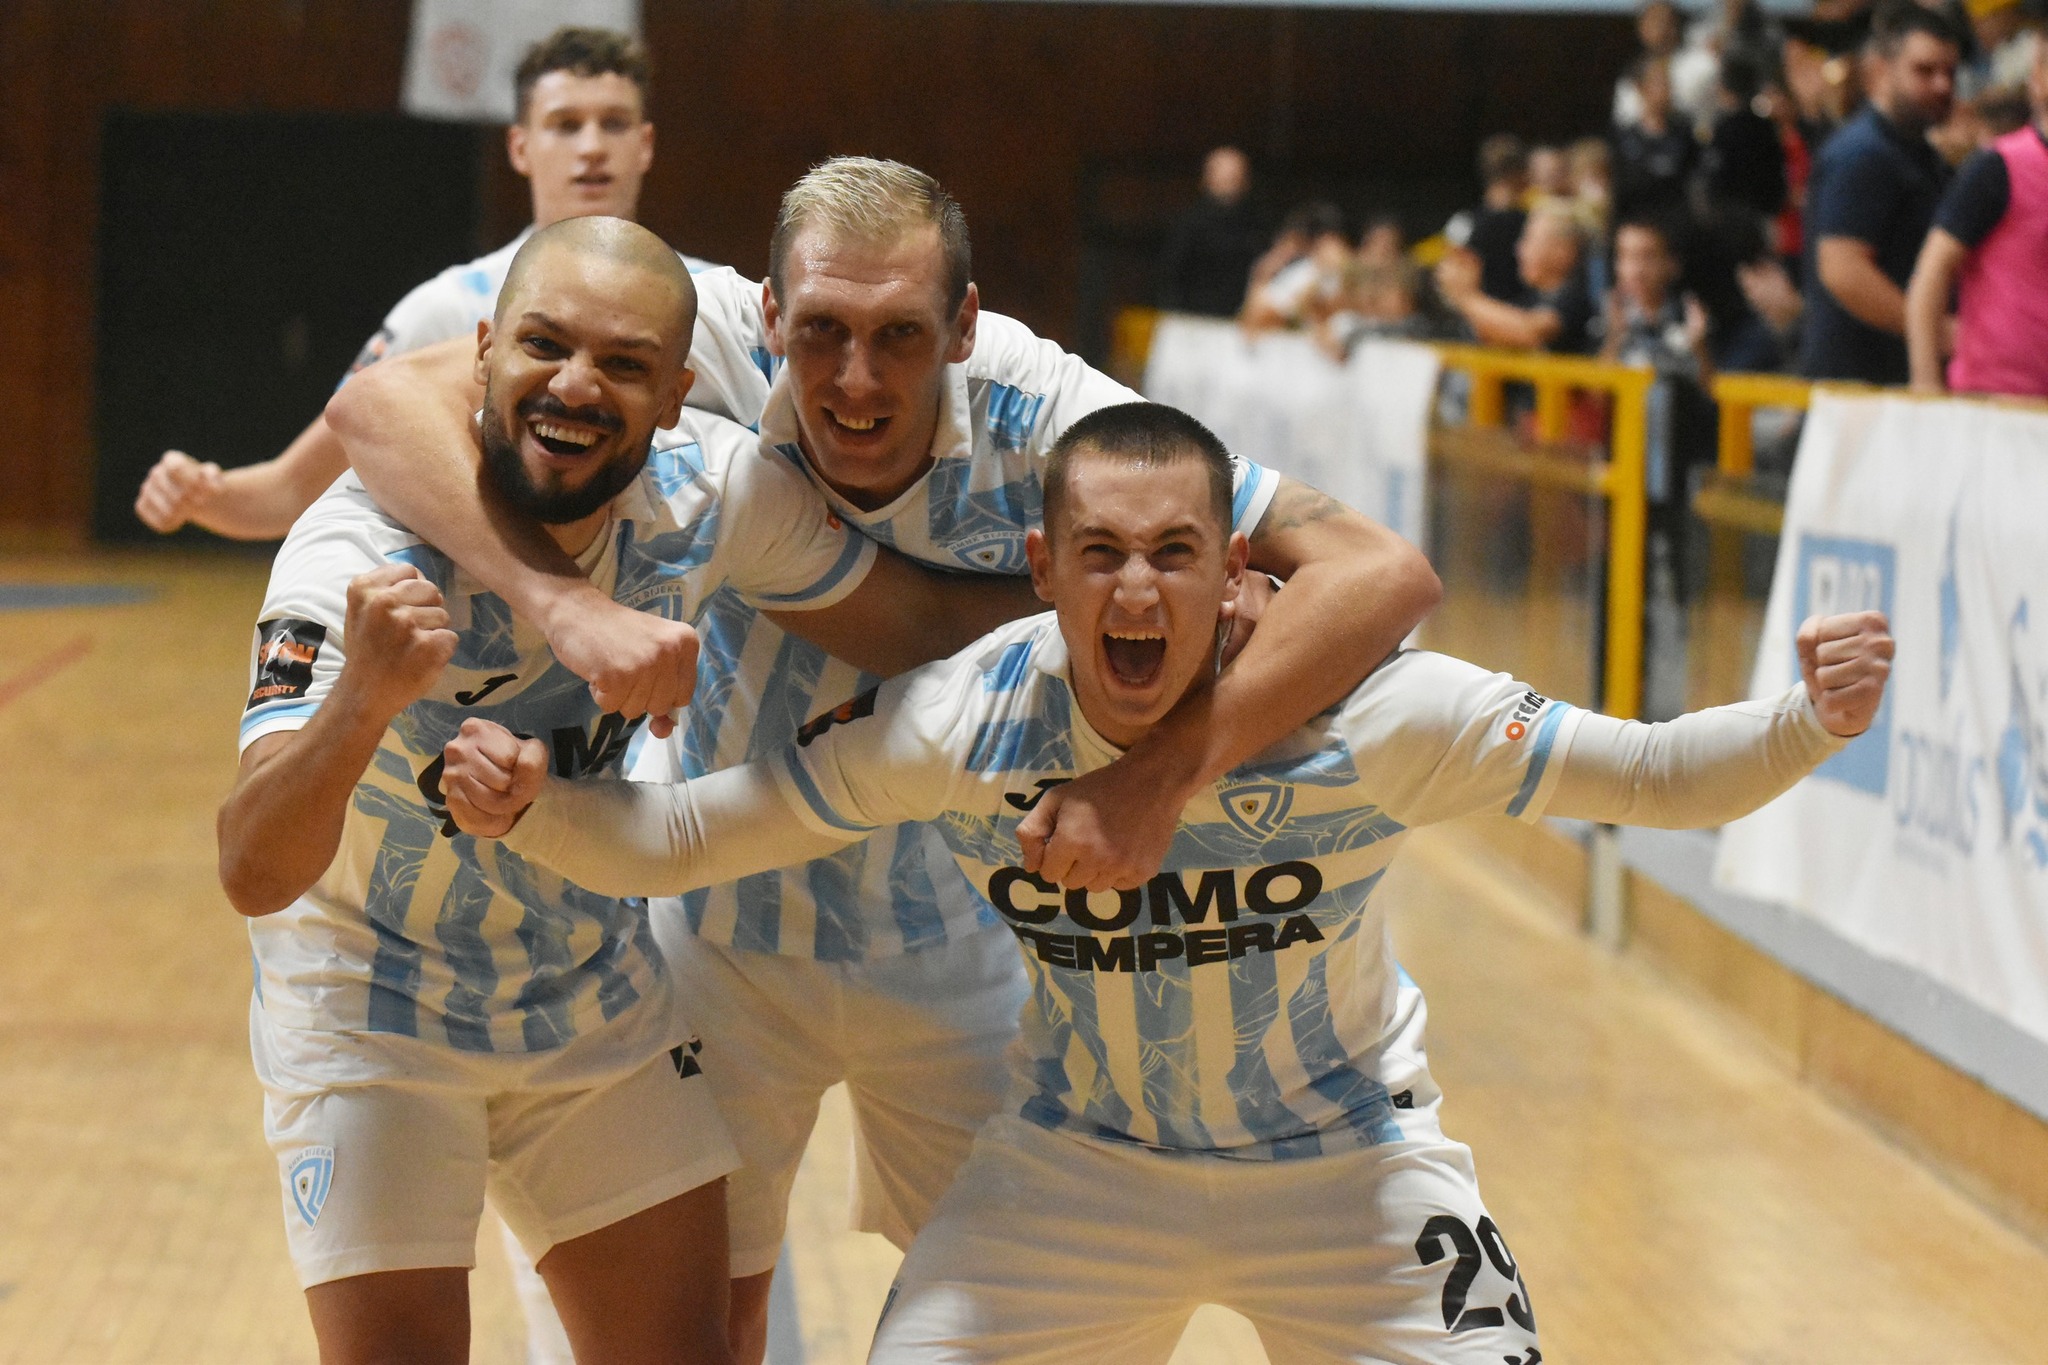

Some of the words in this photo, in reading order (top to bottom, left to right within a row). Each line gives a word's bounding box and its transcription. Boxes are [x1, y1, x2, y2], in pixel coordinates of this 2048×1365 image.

[643, 584, 681, 599] RIJEKA
[259, 640, 315, 664] SRM
[252, 684, 298, 700] SECURITY
[988, 860, 1323, 932] COMO
[1005, 914, 1326, 973] TEMPERA
[1414, 1214, 1537, 1335] 29
